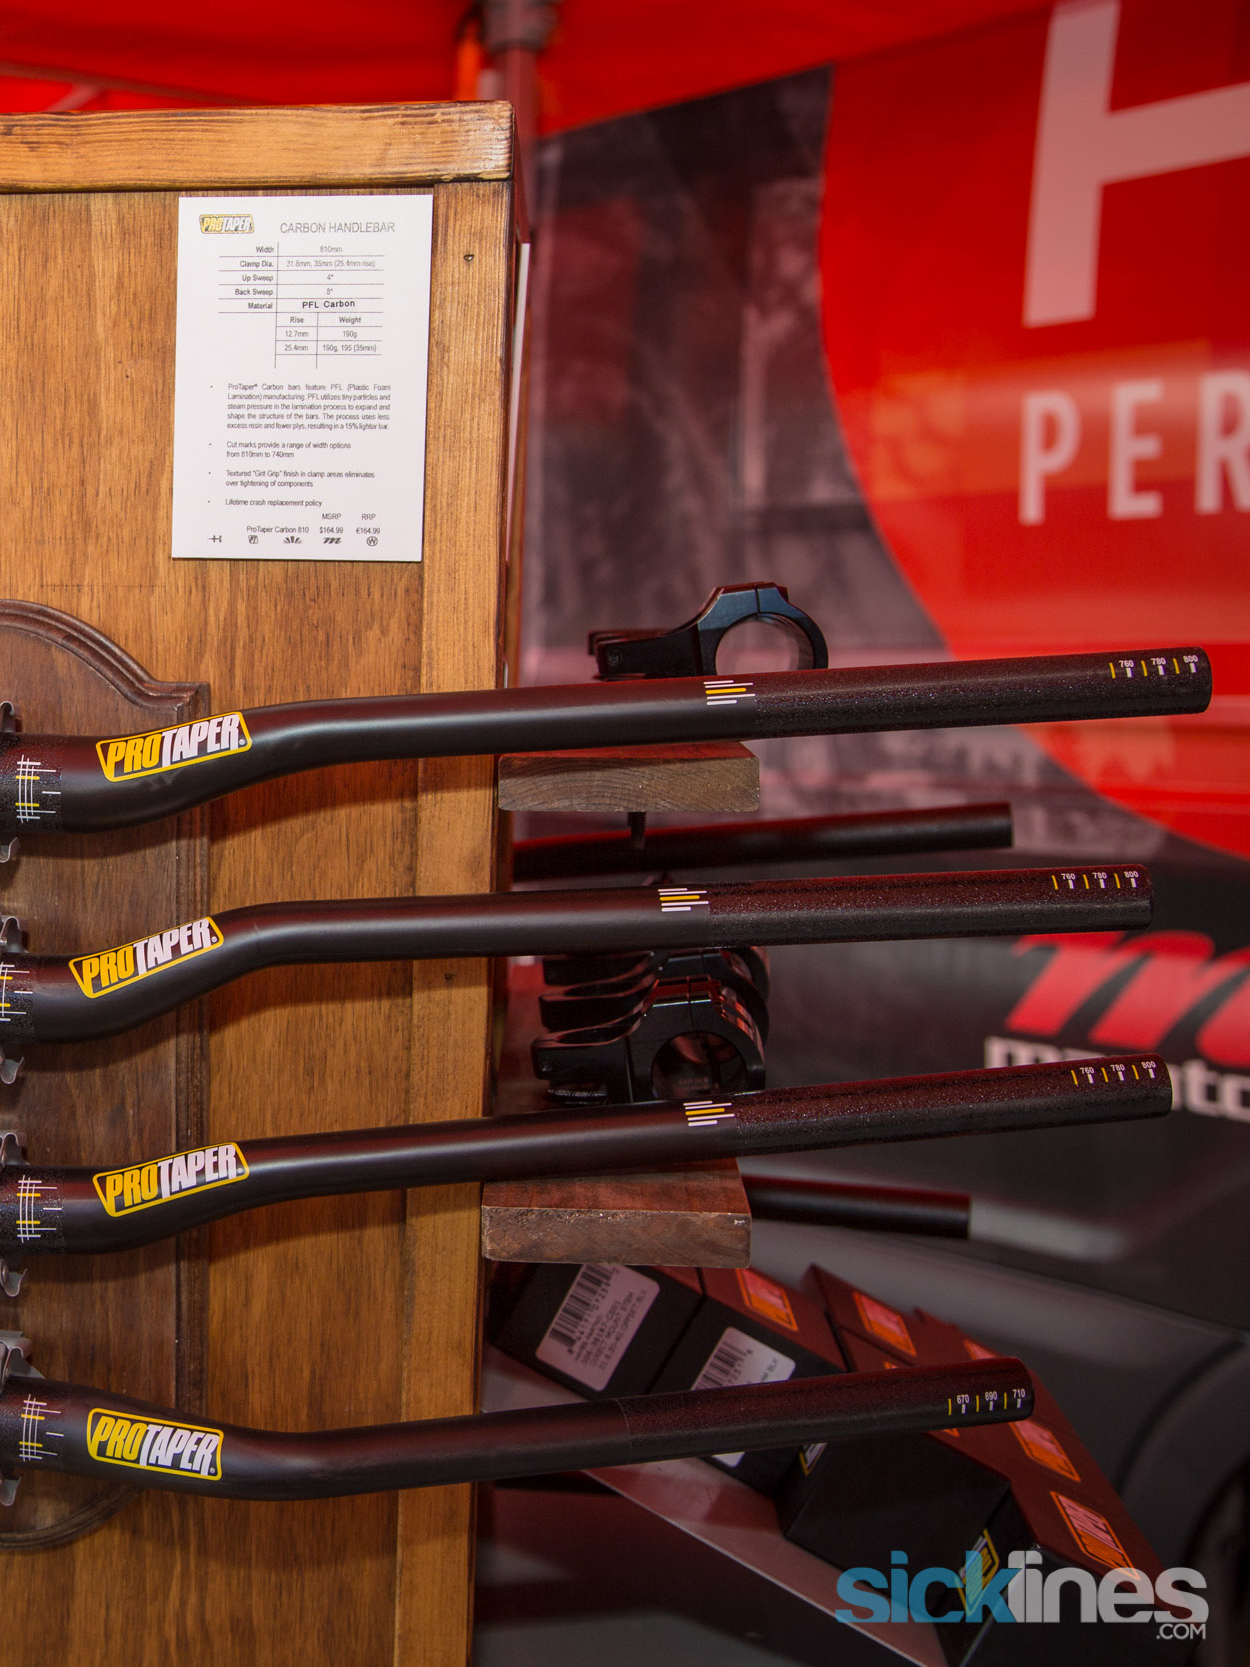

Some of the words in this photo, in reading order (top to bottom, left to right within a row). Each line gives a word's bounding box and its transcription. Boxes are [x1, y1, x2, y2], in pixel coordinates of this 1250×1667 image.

[280, 223, 325, 233] CARBON
[329, 222, 395, 232] HANDLEBAR
[240, 260, 260, 268] Clamp
[362, 260, 375, 268] rise)
[242, 274, 251, 282] Up
[253, 274, 273, 282] Sweep
[252, 288, 273, 296] Sweep
[302, 301, 319, 309] PFL
[323, 300, 355, 308] Carbon
[339, 316, 361, 324] Weight
[343, 330, 357, 338] 190g
[354, 344, 376, 352] (35mm)
[228, 393, 262, 401] Lamination)
[307, 470, 325, 478] clamp
[240, 480, 269, 488] tightening
[267, 499, 304, 507] replacement
[247, 526, 274, 534] ProTaper
[320, 526, 343, 534] $164.99
[1119, 660, 1134, 668] 760
[1151, 657, 1166, 665] 780
[1183, 655, 1198, 663] 800
[957, 1394, 969, 1404] 670
[985, 1391, 997, 1401] 690
[1013, 1388, 1025, 1398] 710
